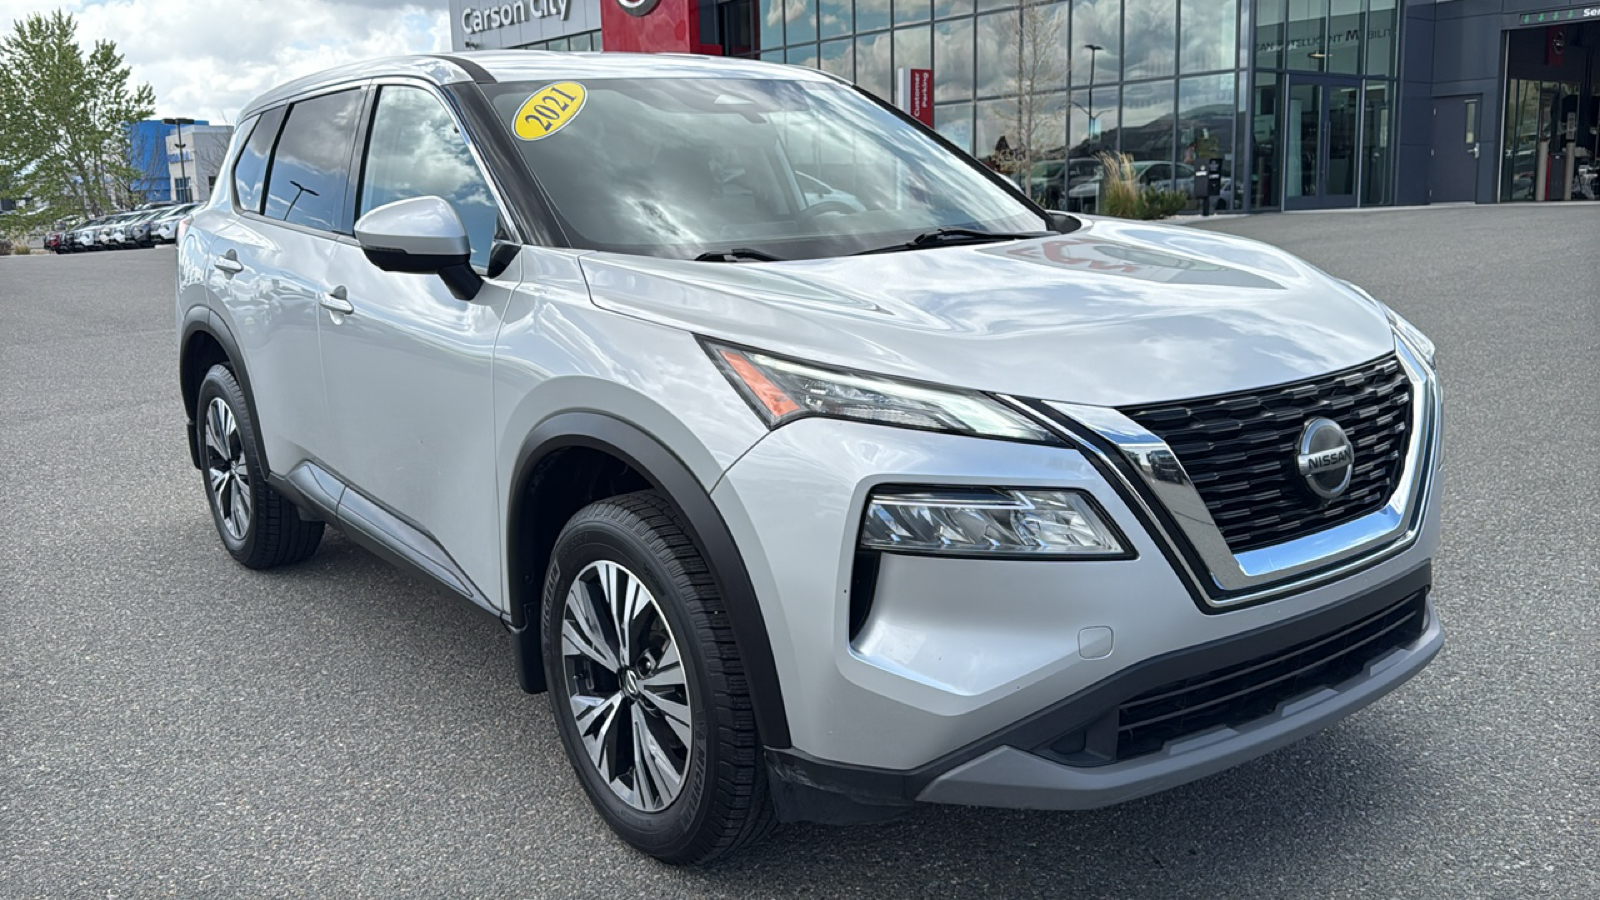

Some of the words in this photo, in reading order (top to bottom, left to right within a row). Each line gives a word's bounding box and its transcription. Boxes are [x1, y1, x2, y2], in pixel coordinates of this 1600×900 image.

[461, 0, 527, 34] Carson
[530, 0, 571, 21] City
[921, 72, 929, 108] Parking
[524, 87, 577, 131] 2021
[1308, 449, 1351, 470] NISSAN
